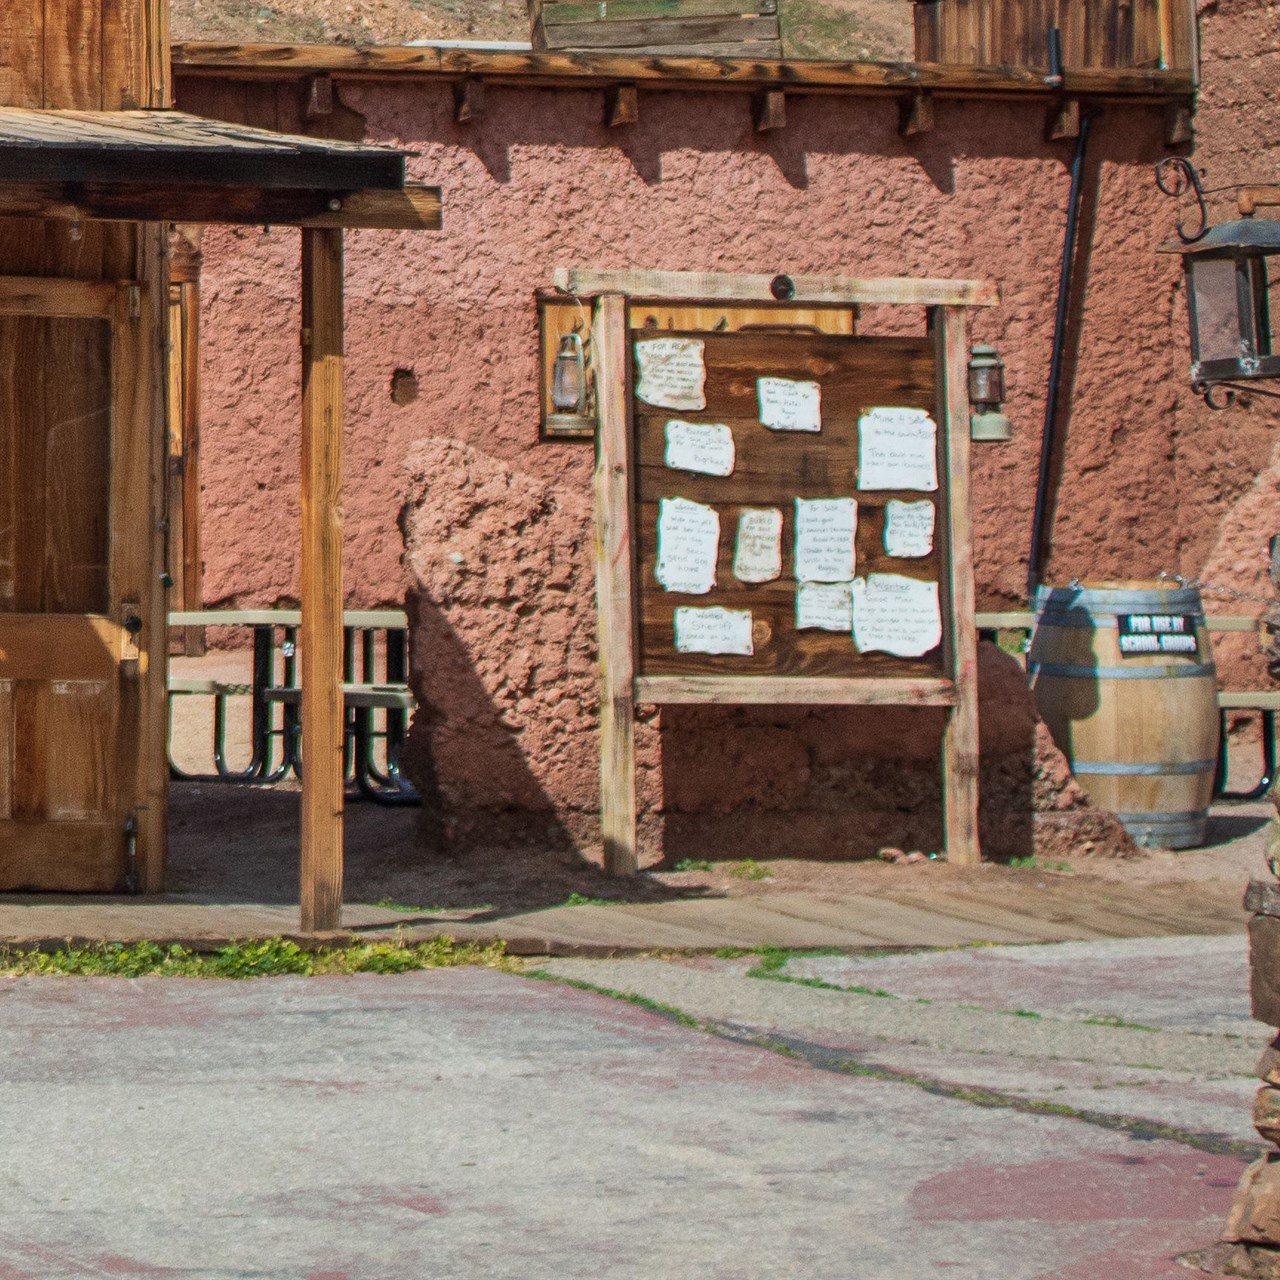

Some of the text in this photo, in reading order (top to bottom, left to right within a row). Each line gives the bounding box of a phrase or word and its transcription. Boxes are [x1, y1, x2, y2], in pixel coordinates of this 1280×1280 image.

[1129, 615, 1151, 632] FOR
[1152, 615, 1171, 632] USE
[1120, 634, 1160, 651] SCHOOL
